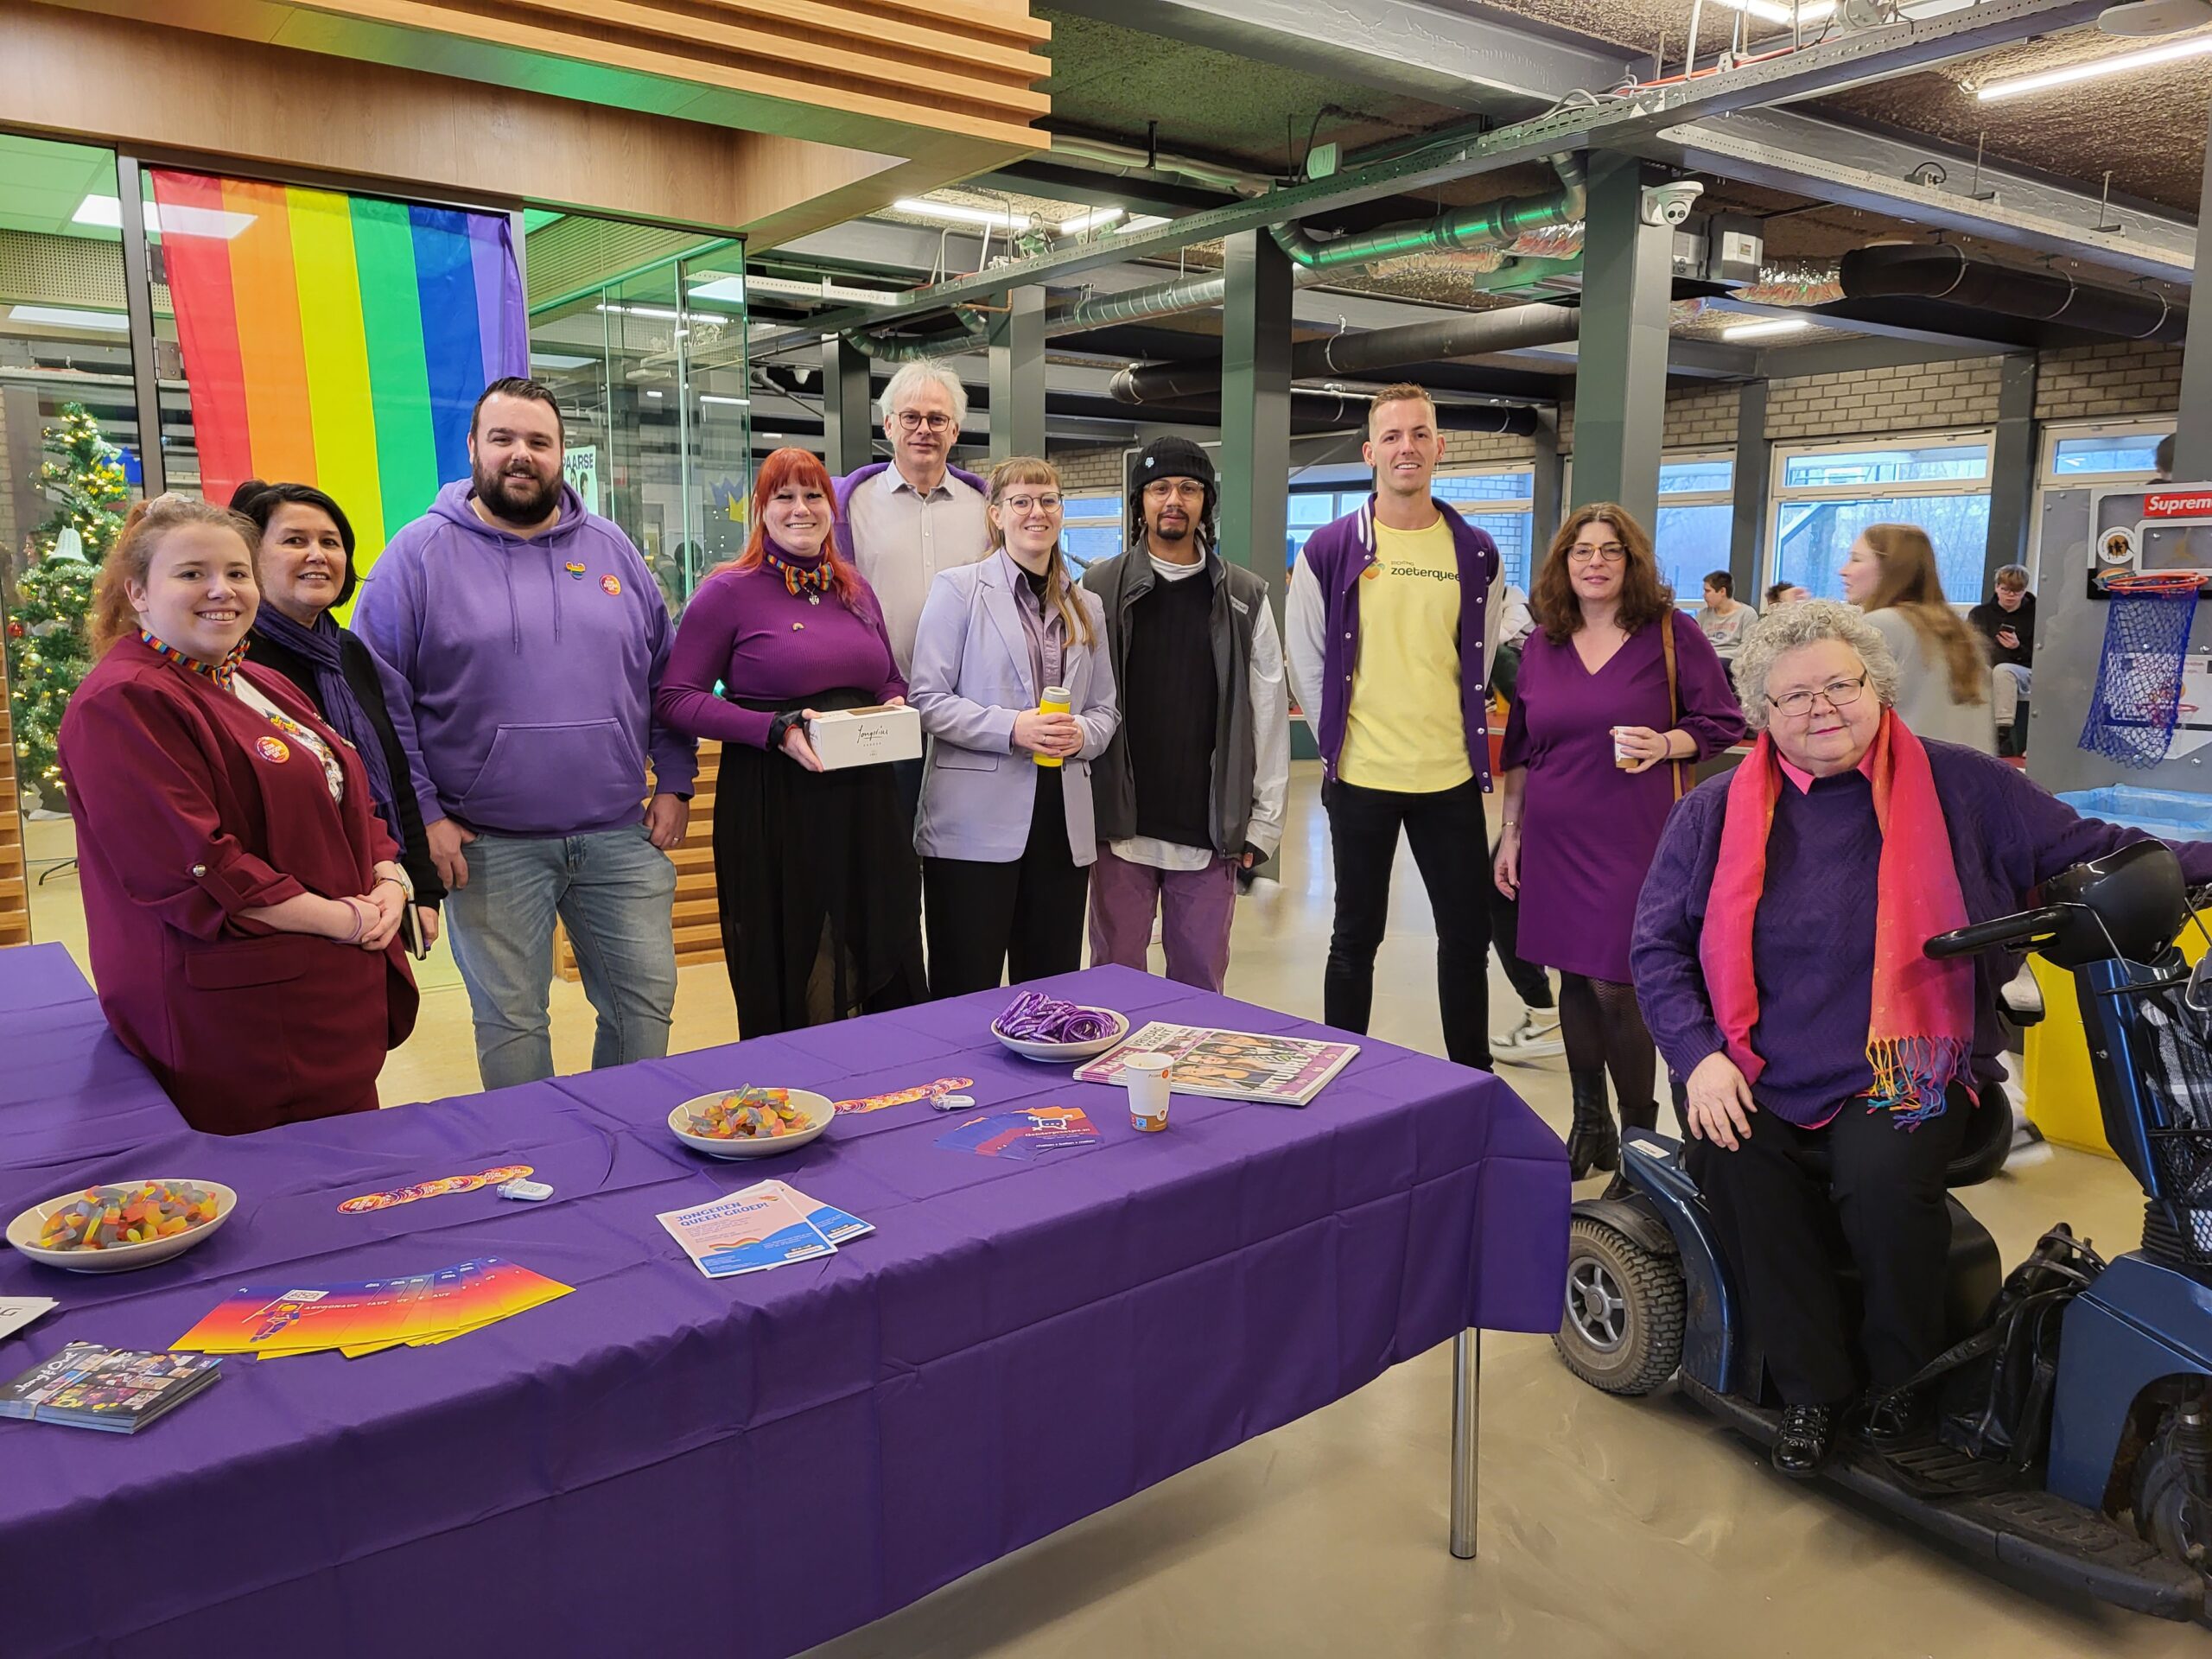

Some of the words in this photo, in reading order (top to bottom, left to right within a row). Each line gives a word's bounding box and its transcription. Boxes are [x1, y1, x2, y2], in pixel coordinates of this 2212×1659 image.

[2148, 496, 2212, 515] Suprem
[1391, 567, 1460, 581] zoeterquee
[1129, 1027, 1165, 1046] VRIJDAG
[1144, 1029, 1173, 1046] KRANT
[675, 1202, 742, 1222] JONGEREN
[680, 1214, 722, 1226] QUEER
[724, 1202, 769, 1217] GROEP!
